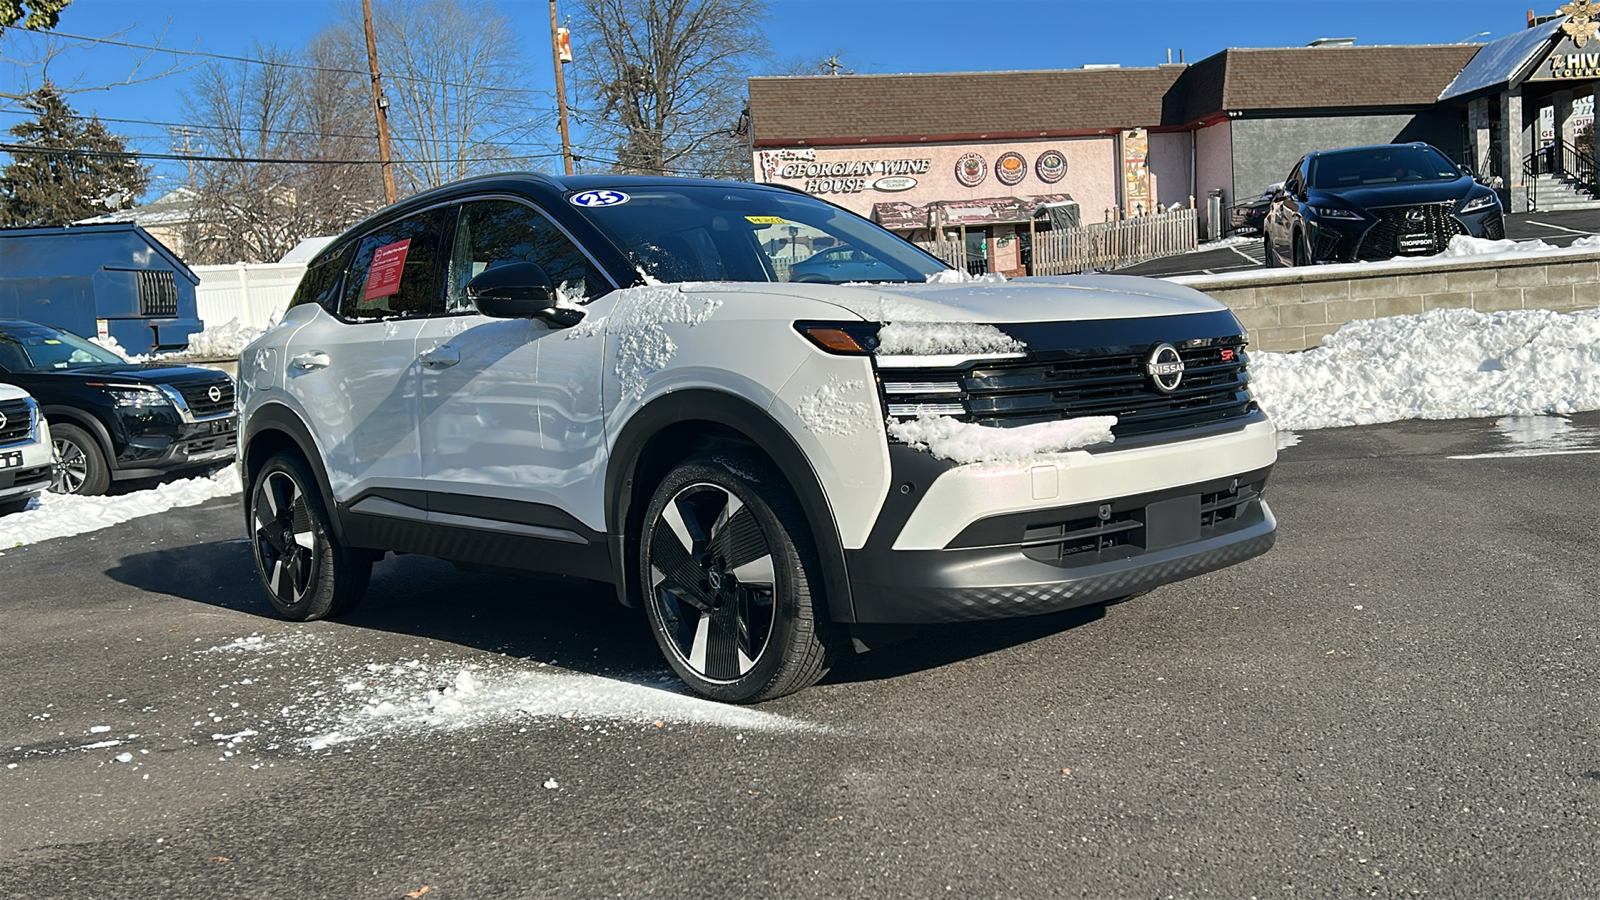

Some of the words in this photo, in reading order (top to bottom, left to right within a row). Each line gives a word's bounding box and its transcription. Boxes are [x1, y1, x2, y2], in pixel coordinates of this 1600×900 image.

[782, 161, 877, 178] GEORGIAN
[882, 159, 931, 175] WINE
[806, 177, 866, 193] HOUSE
[579, 190, 619, 206] 25
[1400, 239, 1433, 247] THOMPSON
[1221, 349, 1234, 360] SR
[1149, 362, 1185, 375] NISSAN
